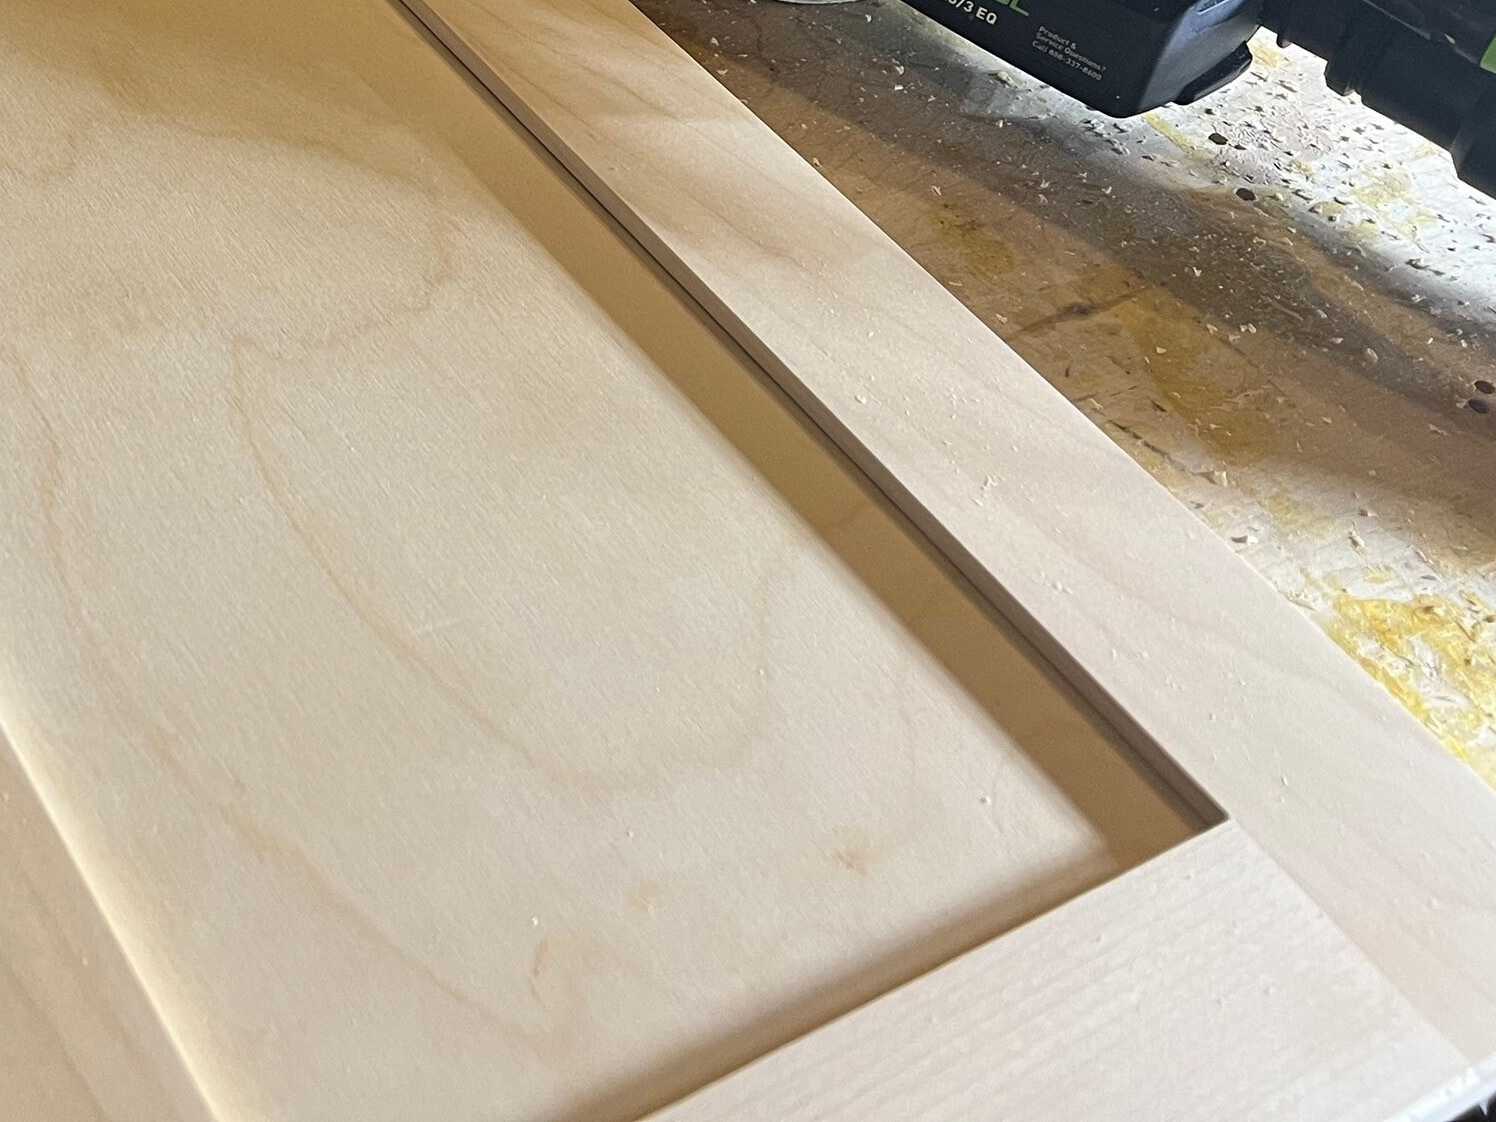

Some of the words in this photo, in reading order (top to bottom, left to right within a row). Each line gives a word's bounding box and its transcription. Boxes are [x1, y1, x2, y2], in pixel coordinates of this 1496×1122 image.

[975, 6, 998, 25] EQ
[1032, 40, 1049, 53] Call
[1039, 26, 1070, 46] Product
[1070, 42, 1077, 50] &
